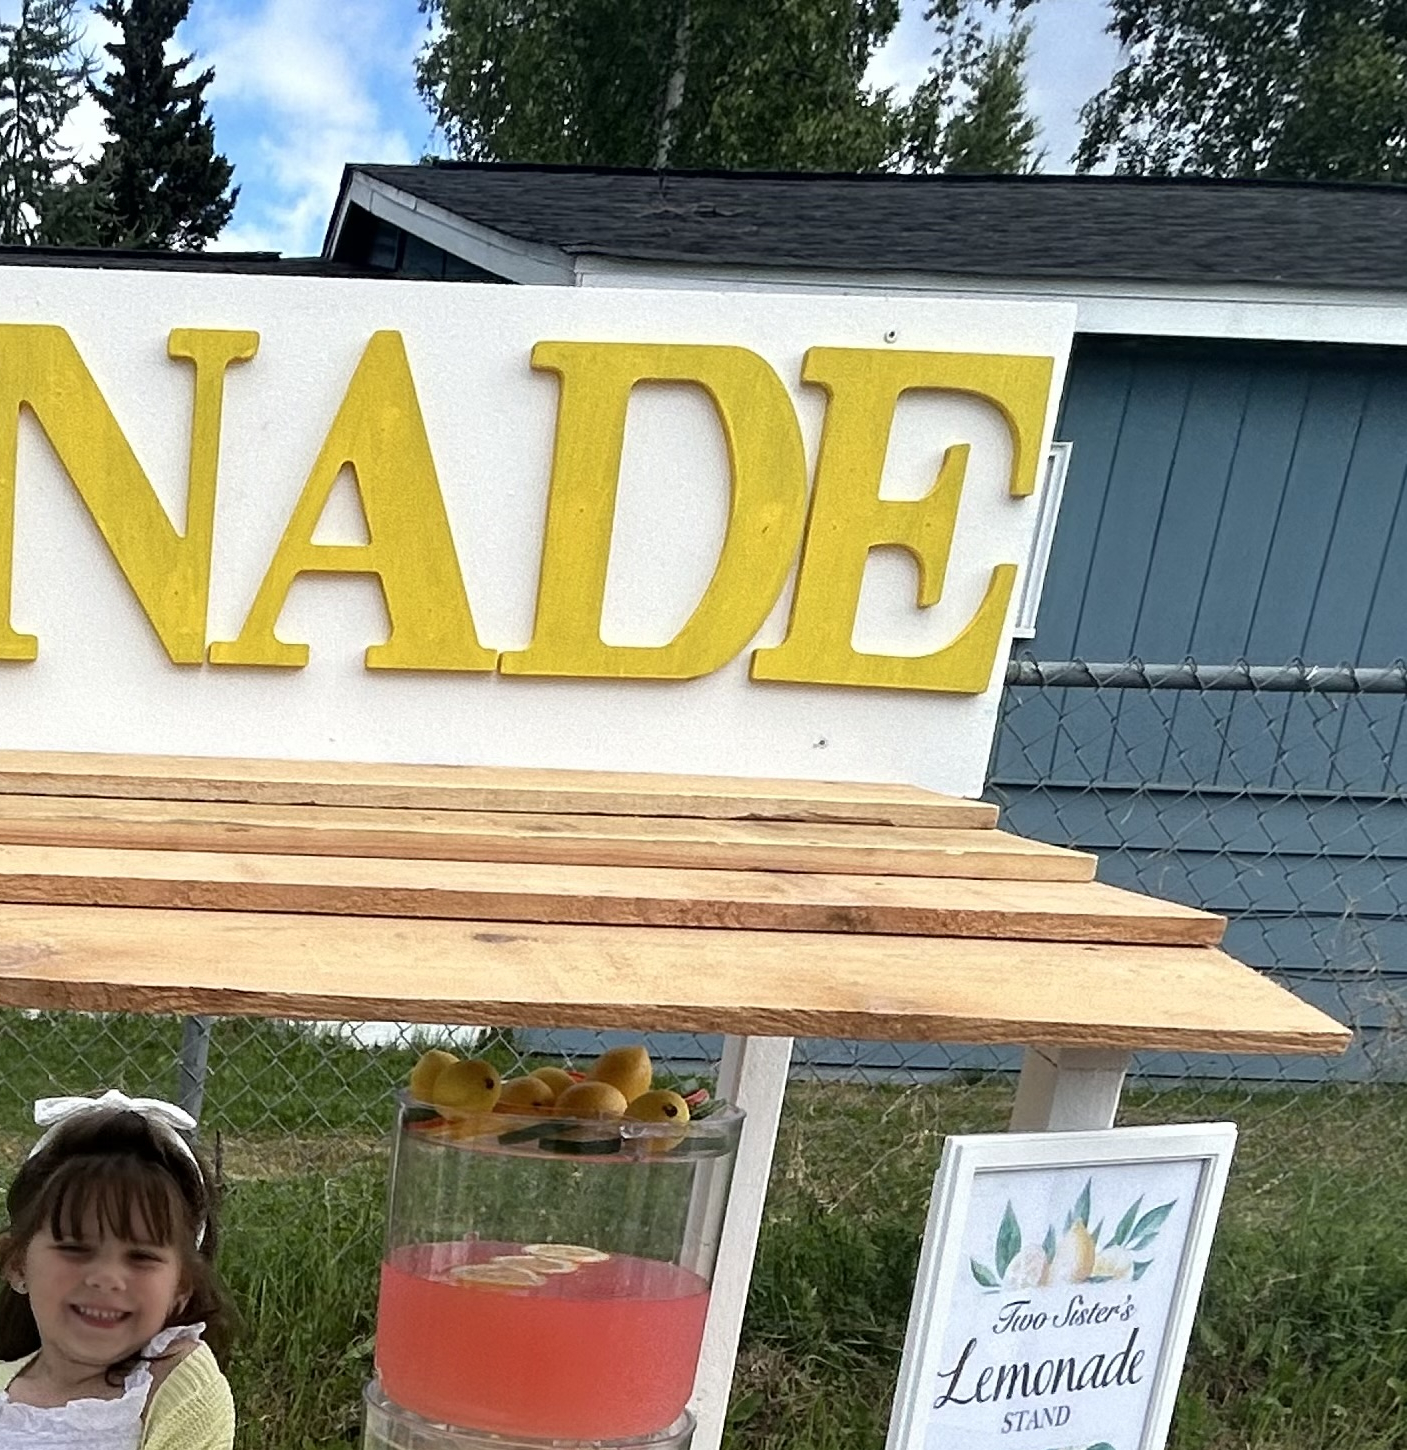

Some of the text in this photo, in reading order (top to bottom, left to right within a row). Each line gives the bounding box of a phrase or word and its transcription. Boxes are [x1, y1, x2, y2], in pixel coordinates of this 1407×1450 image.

[992, 1294, 1138, 1336] Two Sister's
[931, 1327, 1148, 1410] Lemonade
[1000, 1404, 1072, 1435] STAND
